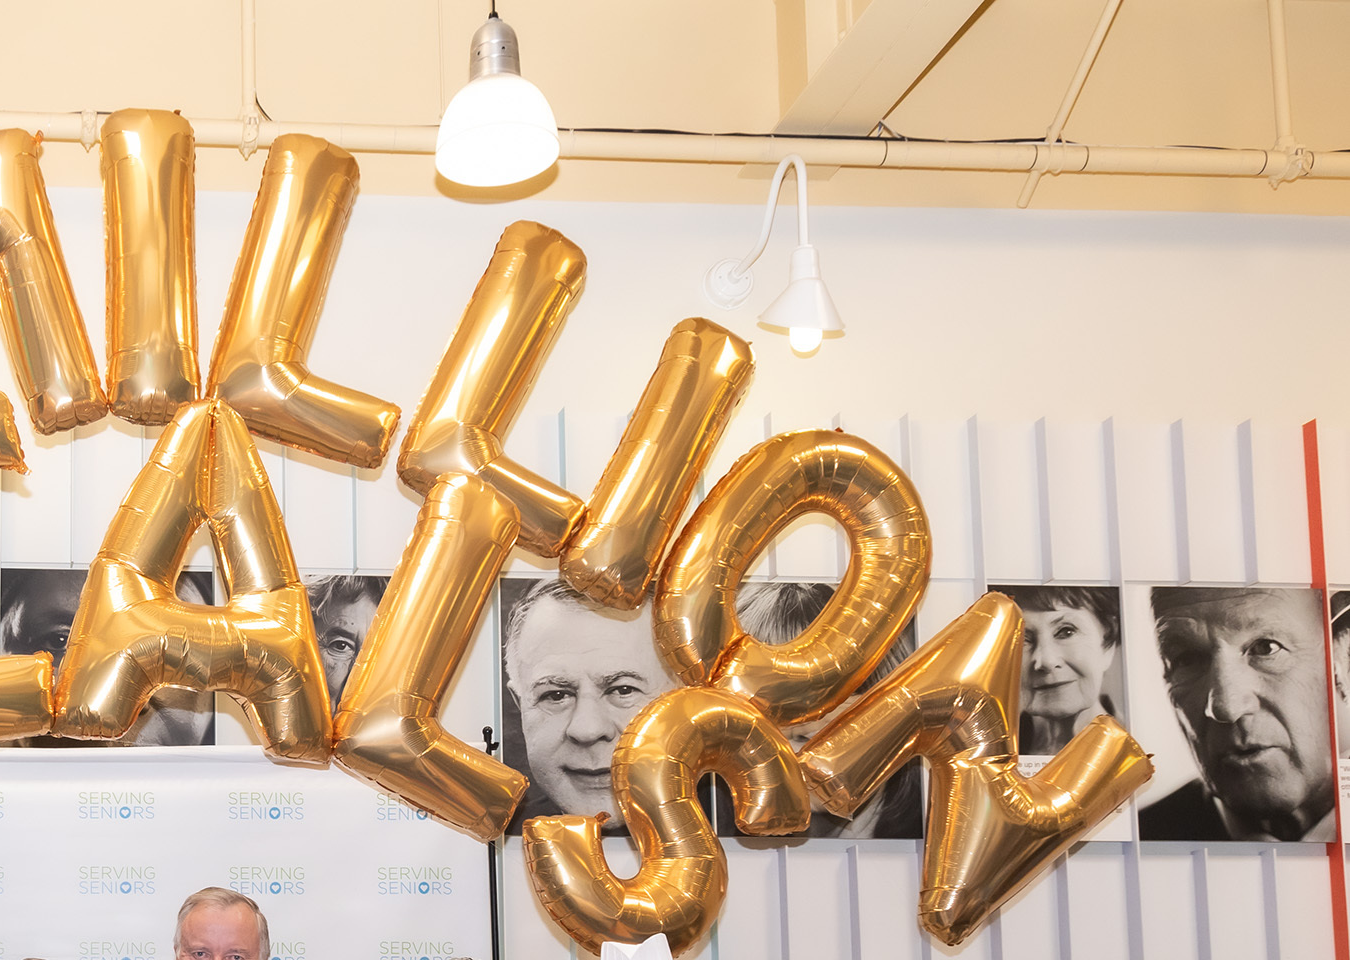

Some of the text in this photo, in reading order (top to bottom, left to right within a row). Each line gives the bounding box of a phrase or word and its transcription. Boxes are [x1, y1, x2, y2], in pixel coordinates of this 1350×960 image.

[78, 791, 155, 805] SERVING
[228, 792, 304, 805] SERVING
[78, 806, 155, 819] SENIORS
[228, 807, 304, 820] SENIORS
[79, 866, 155, 880] SERVING
[229, 867, 305, 880] SERVING
[378, 867, 452, 880] SERVING
[79, 881, 155, 894] SENIORS
[229, 881, 305, 895] SENIORS
[378, 881, 452, 895] SENIORS
[79, 942, 156, 955] SERVING
[379, 942, 454, 955] SERVING
